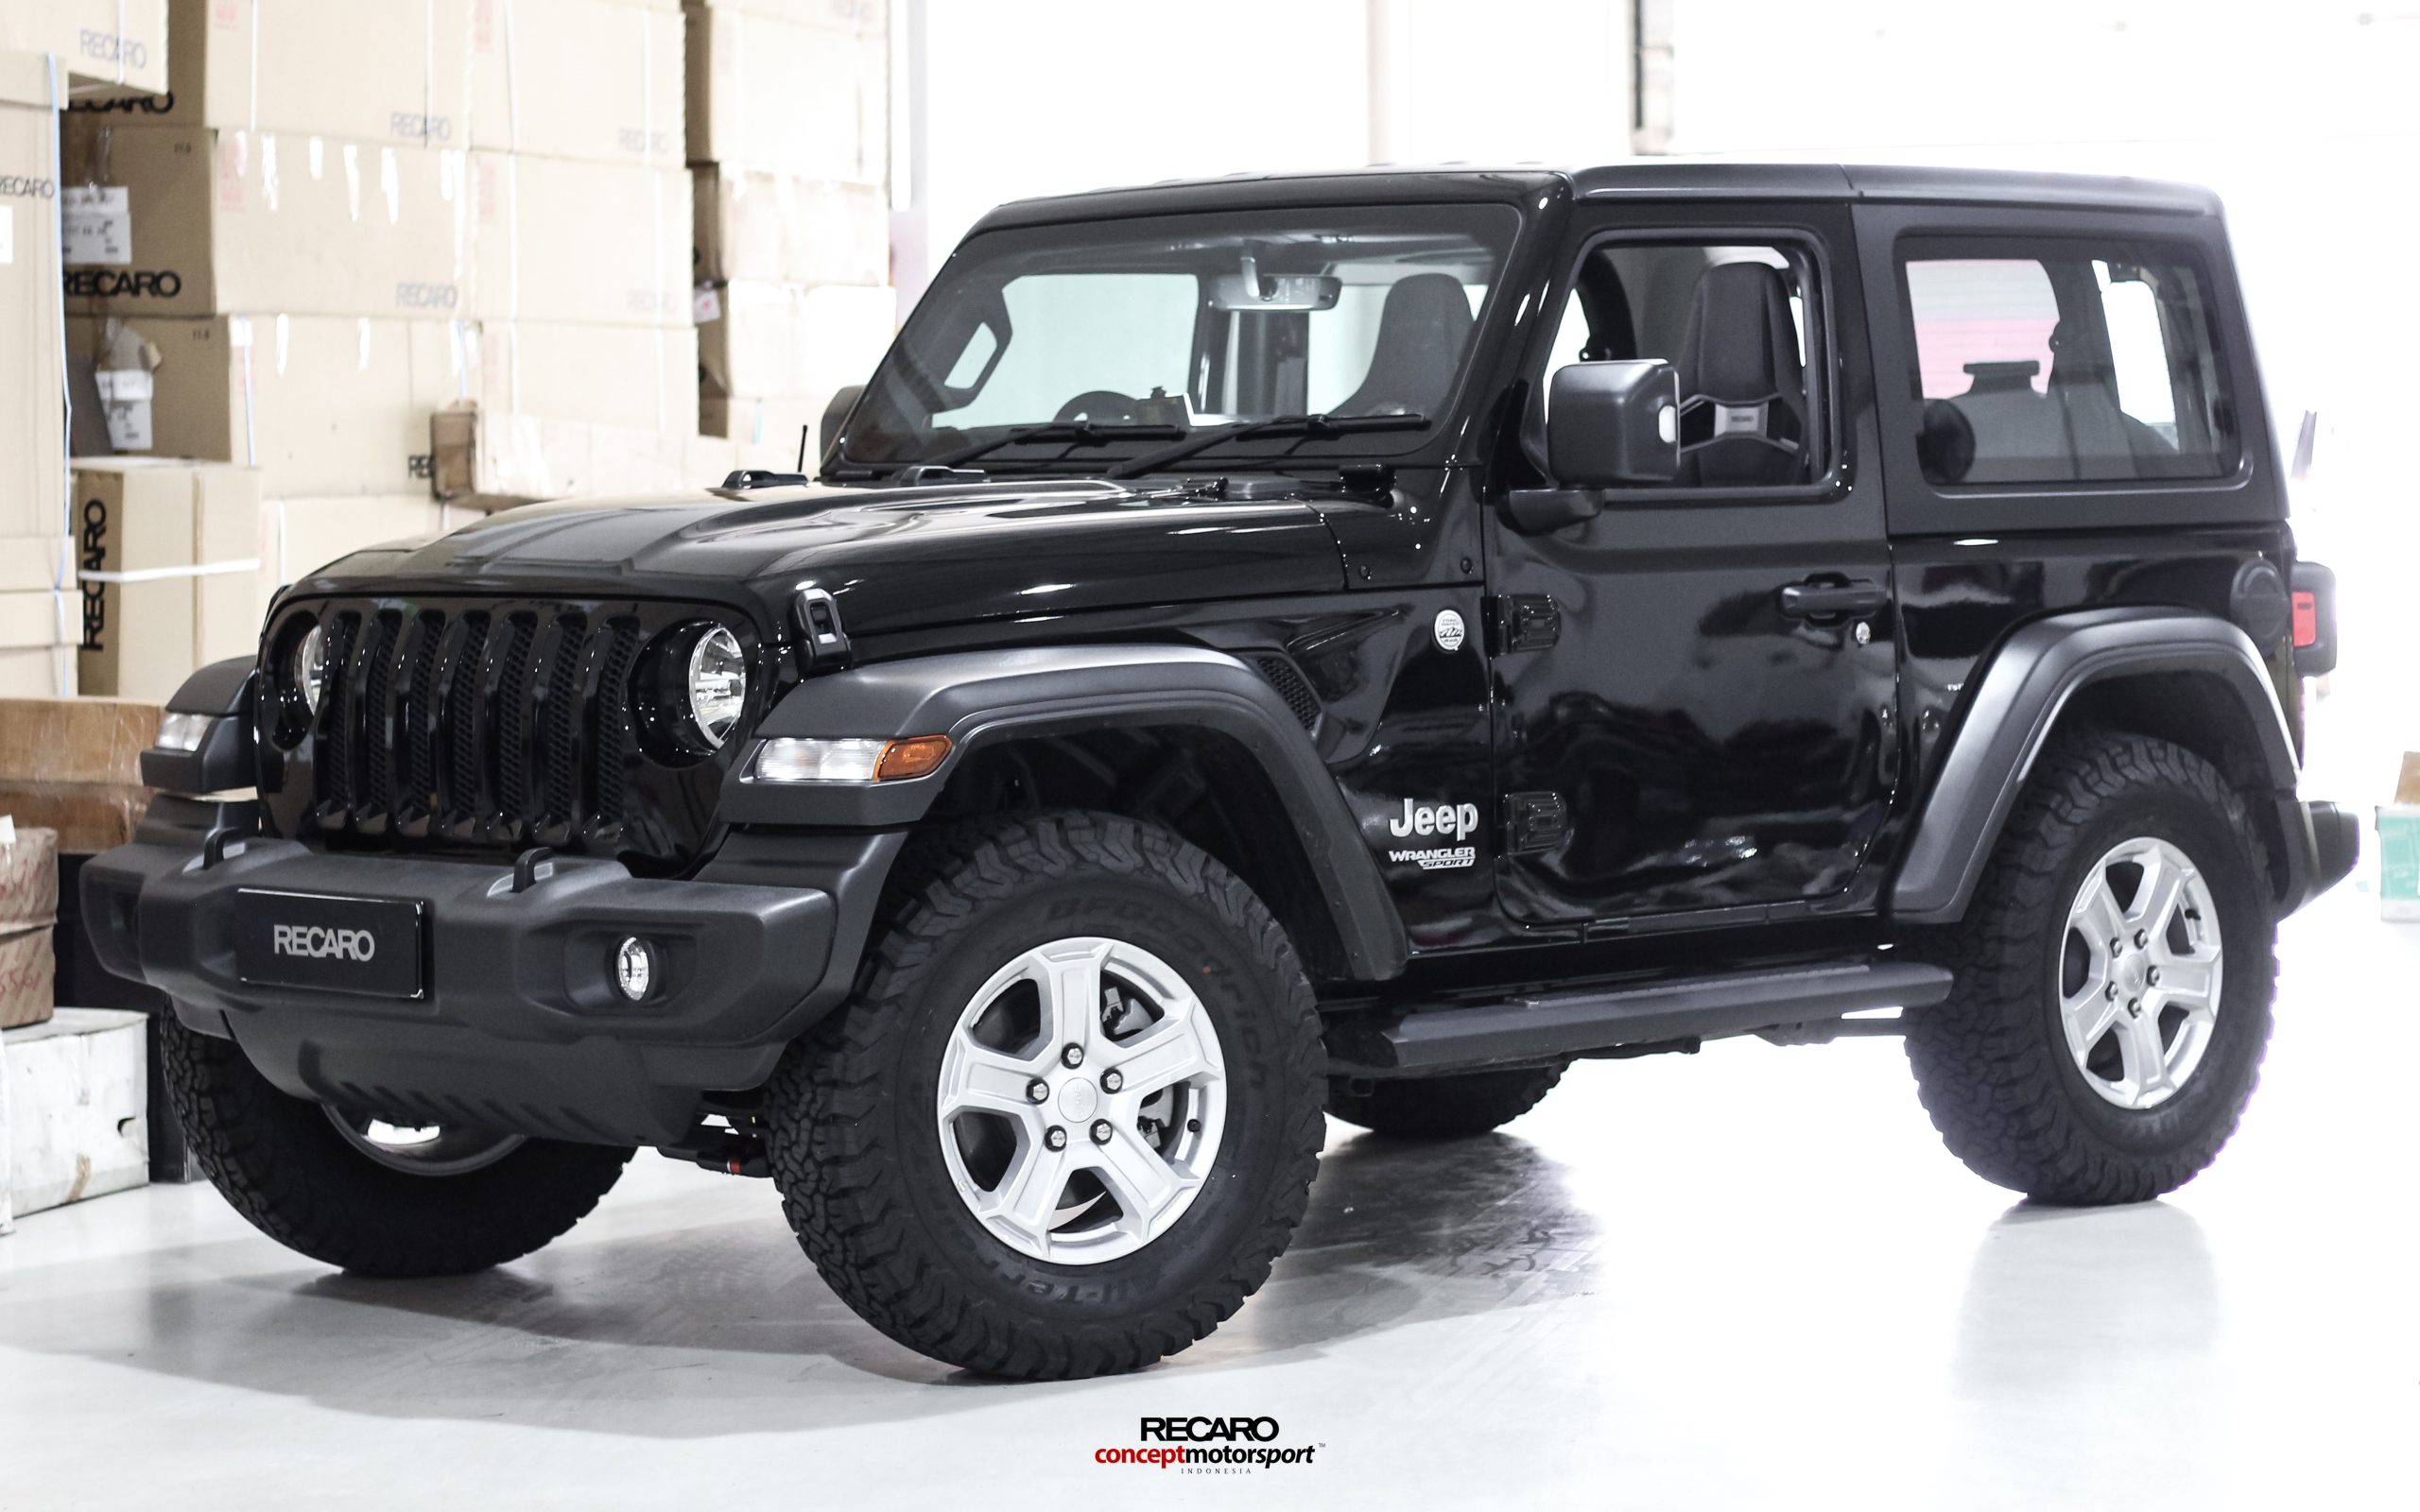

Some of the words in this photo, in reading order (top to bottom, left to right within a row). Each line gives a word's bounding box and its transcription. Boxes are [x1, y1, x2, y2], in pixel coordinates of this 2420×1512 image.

[81, 499, 107, 651] RECARO
[1390, 798, 1478, 841] Jeep
[1389, 847, 1476, 862] WRANGLER
[1422, 858, 1473, 868] SPORT
[274, 924, 374, 962] RECARO
